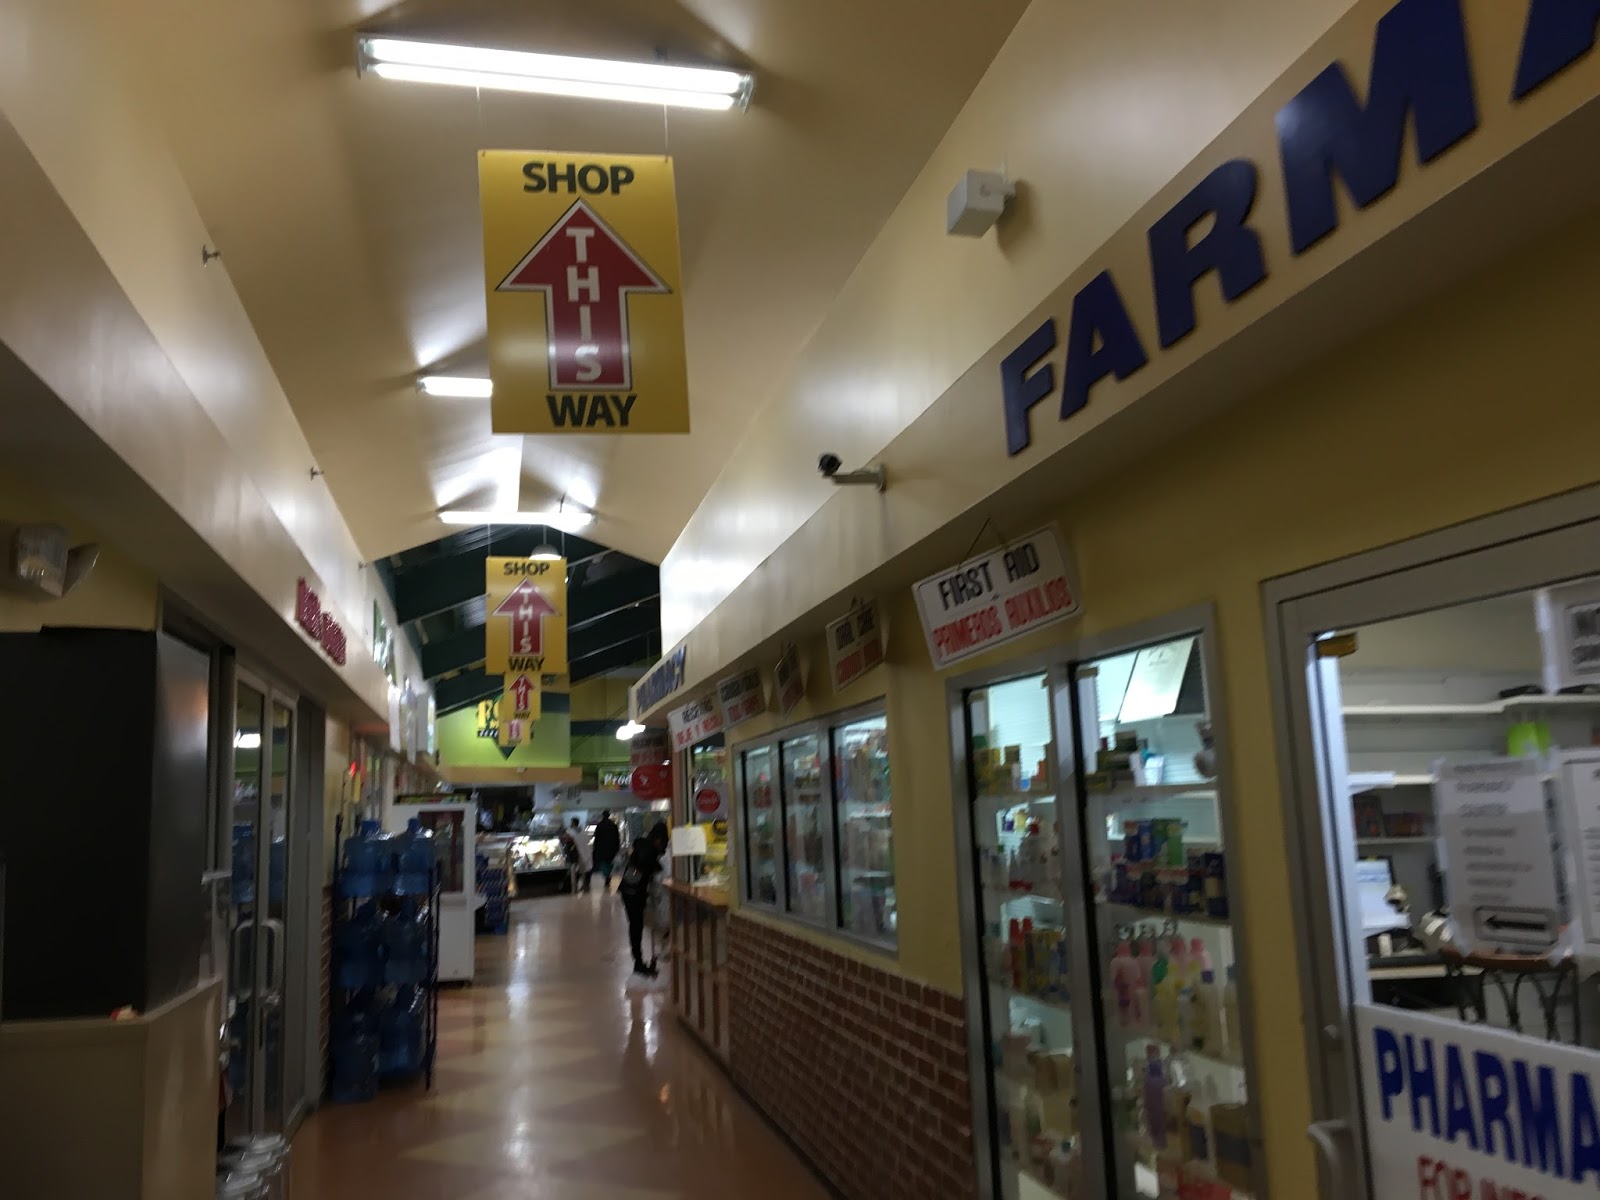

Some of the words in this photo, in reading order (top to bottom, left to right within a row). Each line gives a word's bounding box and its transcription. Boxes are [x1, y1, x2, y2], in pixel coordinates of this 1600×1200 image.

[522, 162, 634, 195] SHOP
[565, 226, 602, 382] THIS
[546, 394, 637, 428] WAY
[503, 561, 550, 576] SHOP
[937, 560, 994, 612] FIRST
[1002, 541, 1040, 584] AID
[518, 587, 534, 654] THIS
[508, 656, 546, 672] WAY
